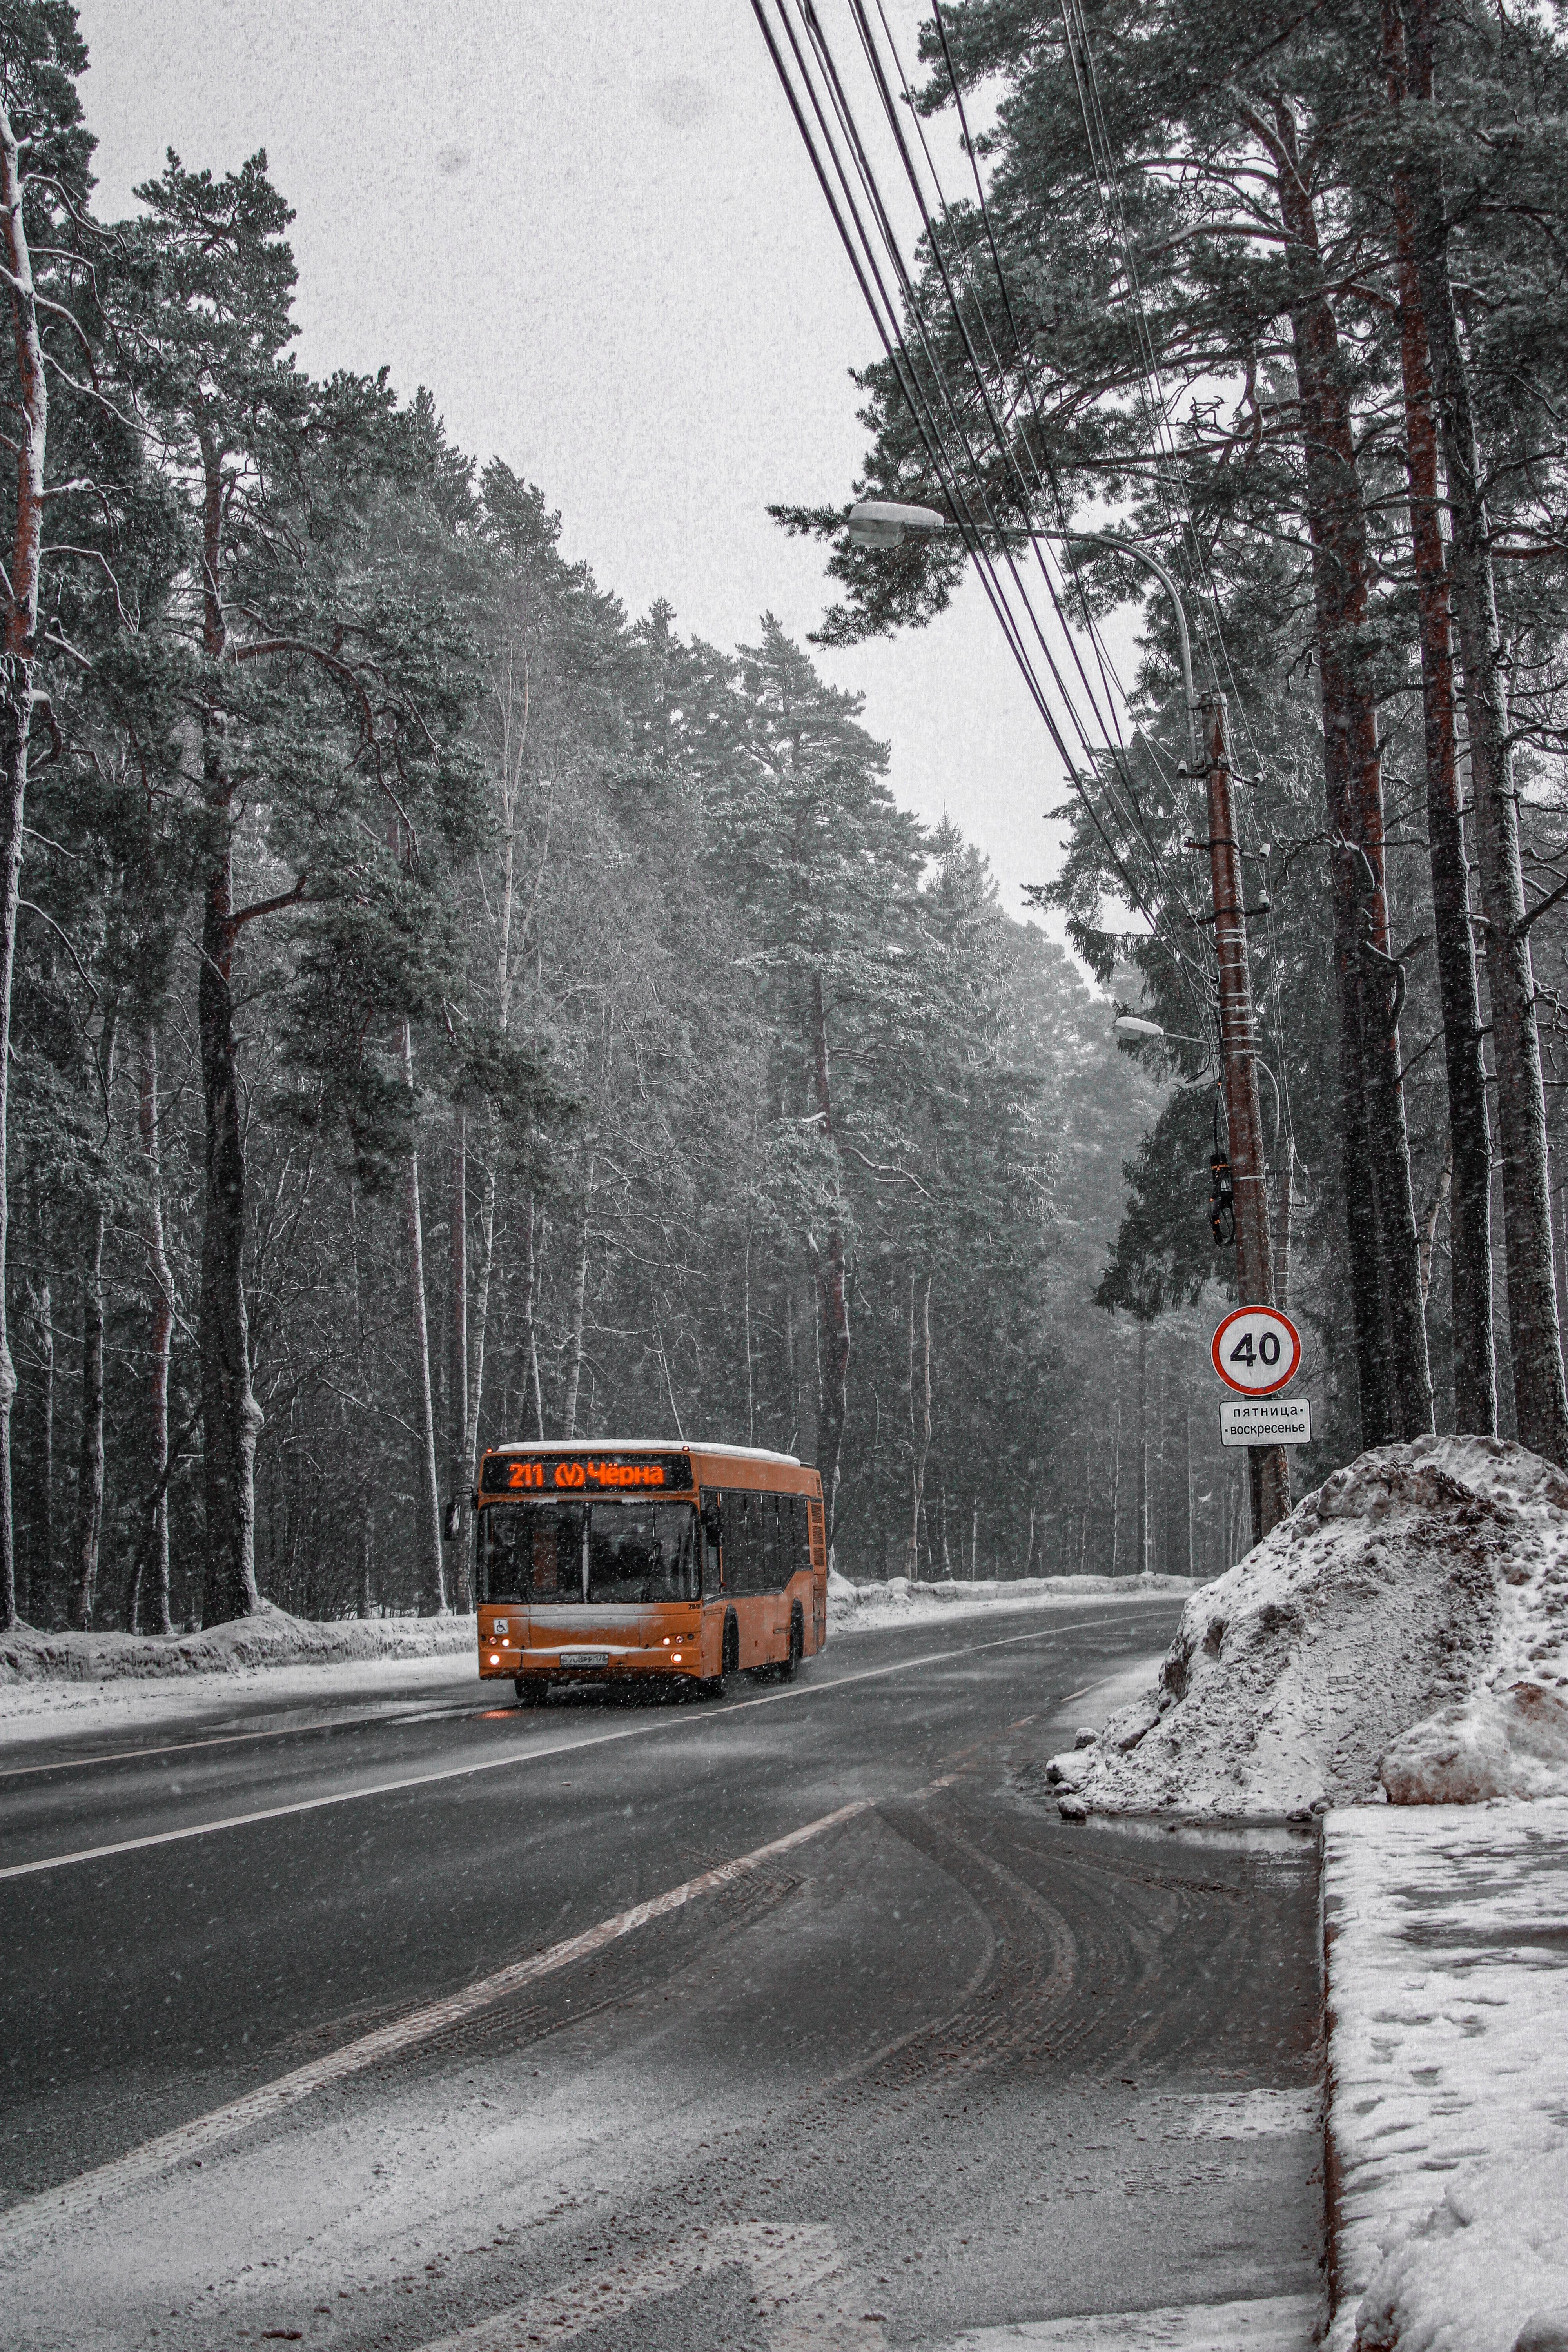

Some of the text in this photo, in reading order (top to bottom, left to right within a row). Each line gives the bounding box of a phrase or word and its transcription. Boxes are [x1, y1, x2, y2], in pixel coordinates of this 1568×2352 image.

[1230, 1332, 1281, 1367] 40
[510, 1463, 543, 1486] 211
[588, 1462, 664, 1485] Чёрна
